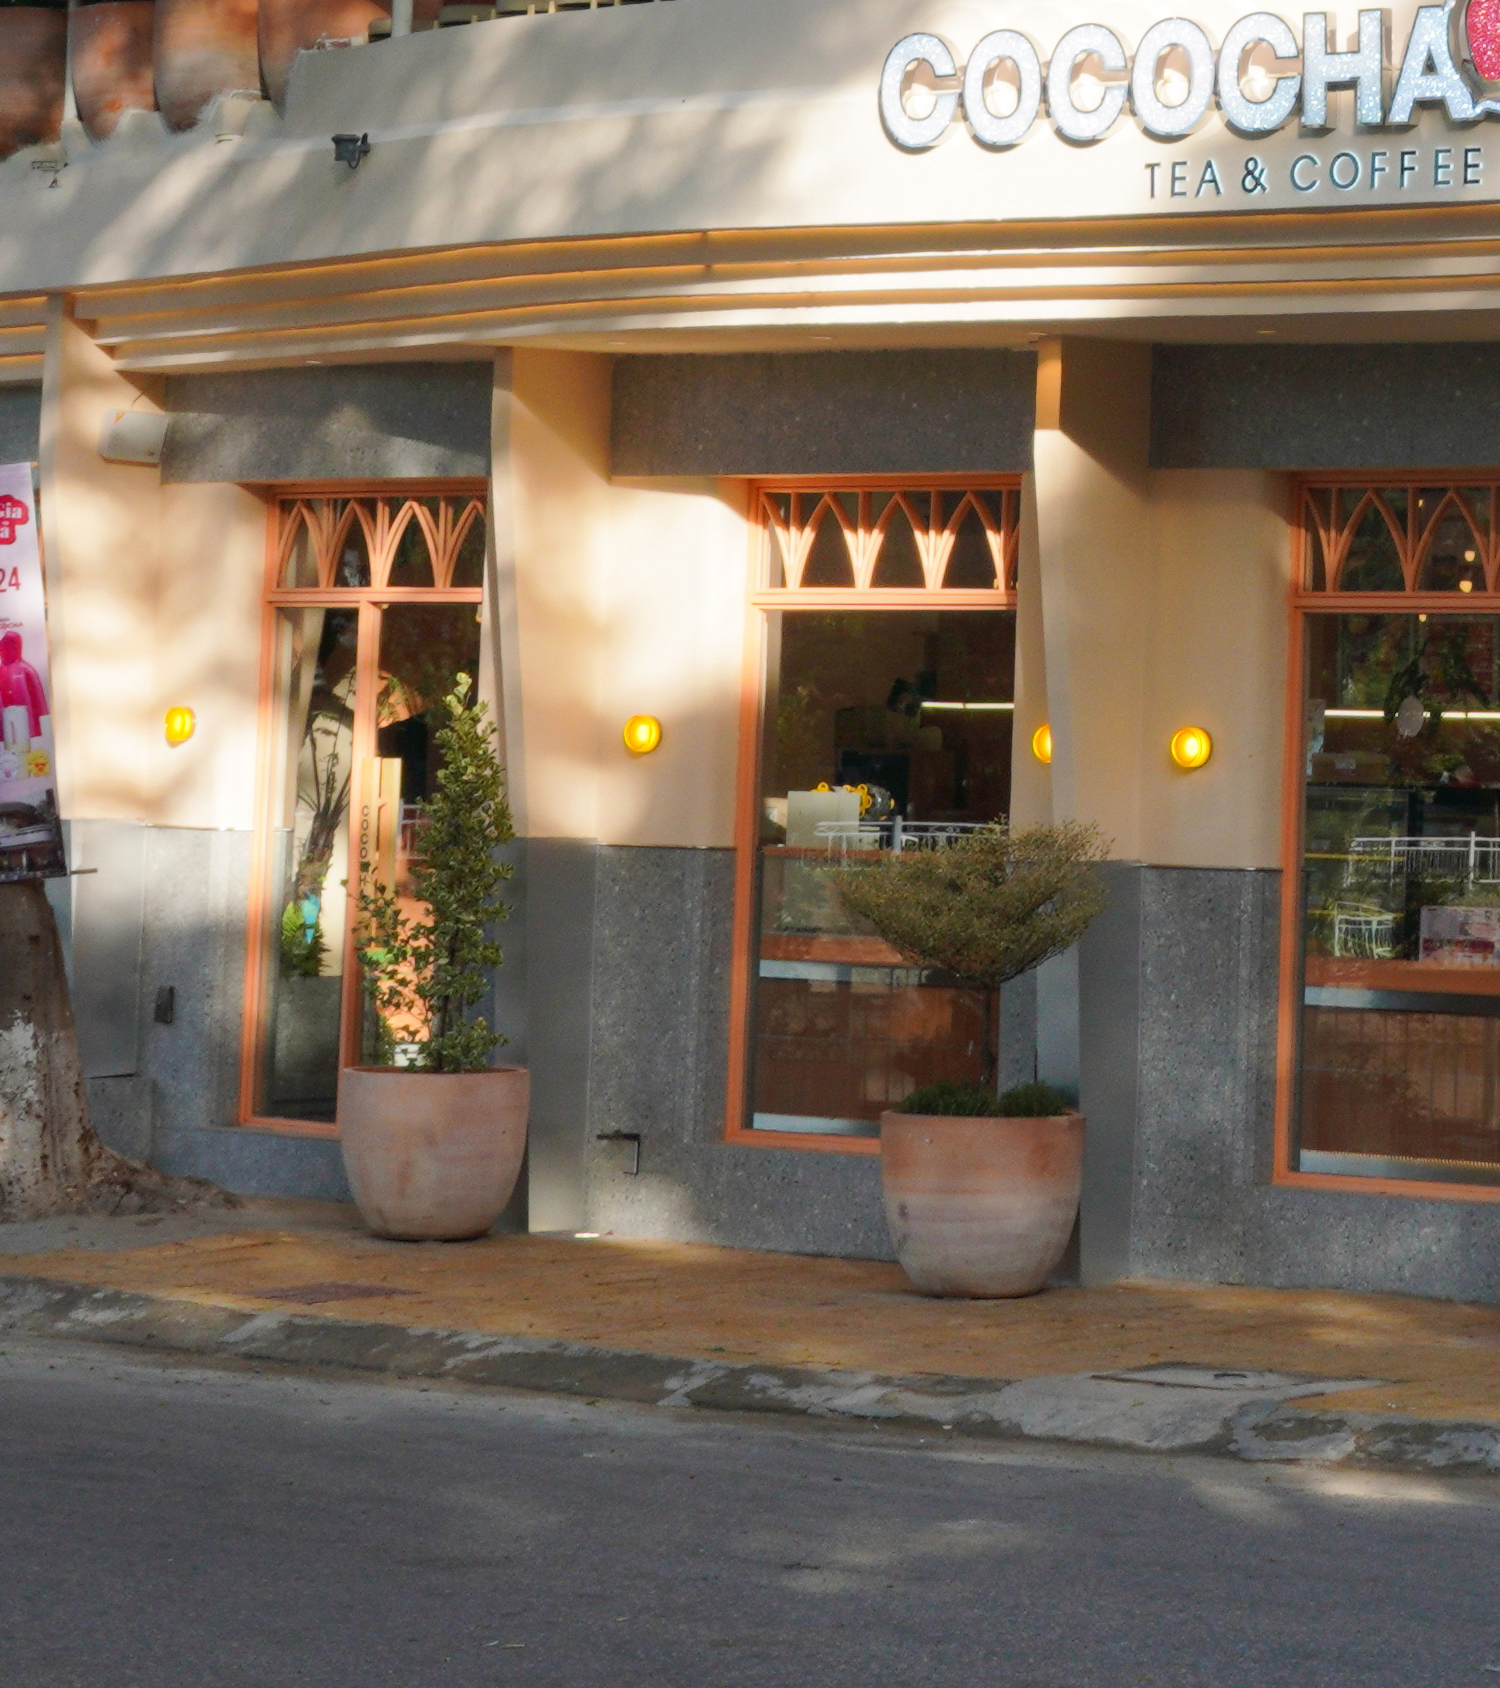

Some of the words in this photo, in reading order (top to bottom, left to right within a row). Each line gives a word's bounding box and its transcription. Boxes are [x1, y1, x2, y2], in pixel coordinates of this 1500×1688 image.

[879, 5, 1485, 150] COCOCHA
[1145, 159, 1222, 199] TEA
[1241, 156, 1268, 194] &
[1290, 147, 1484, 192] COFFEE
